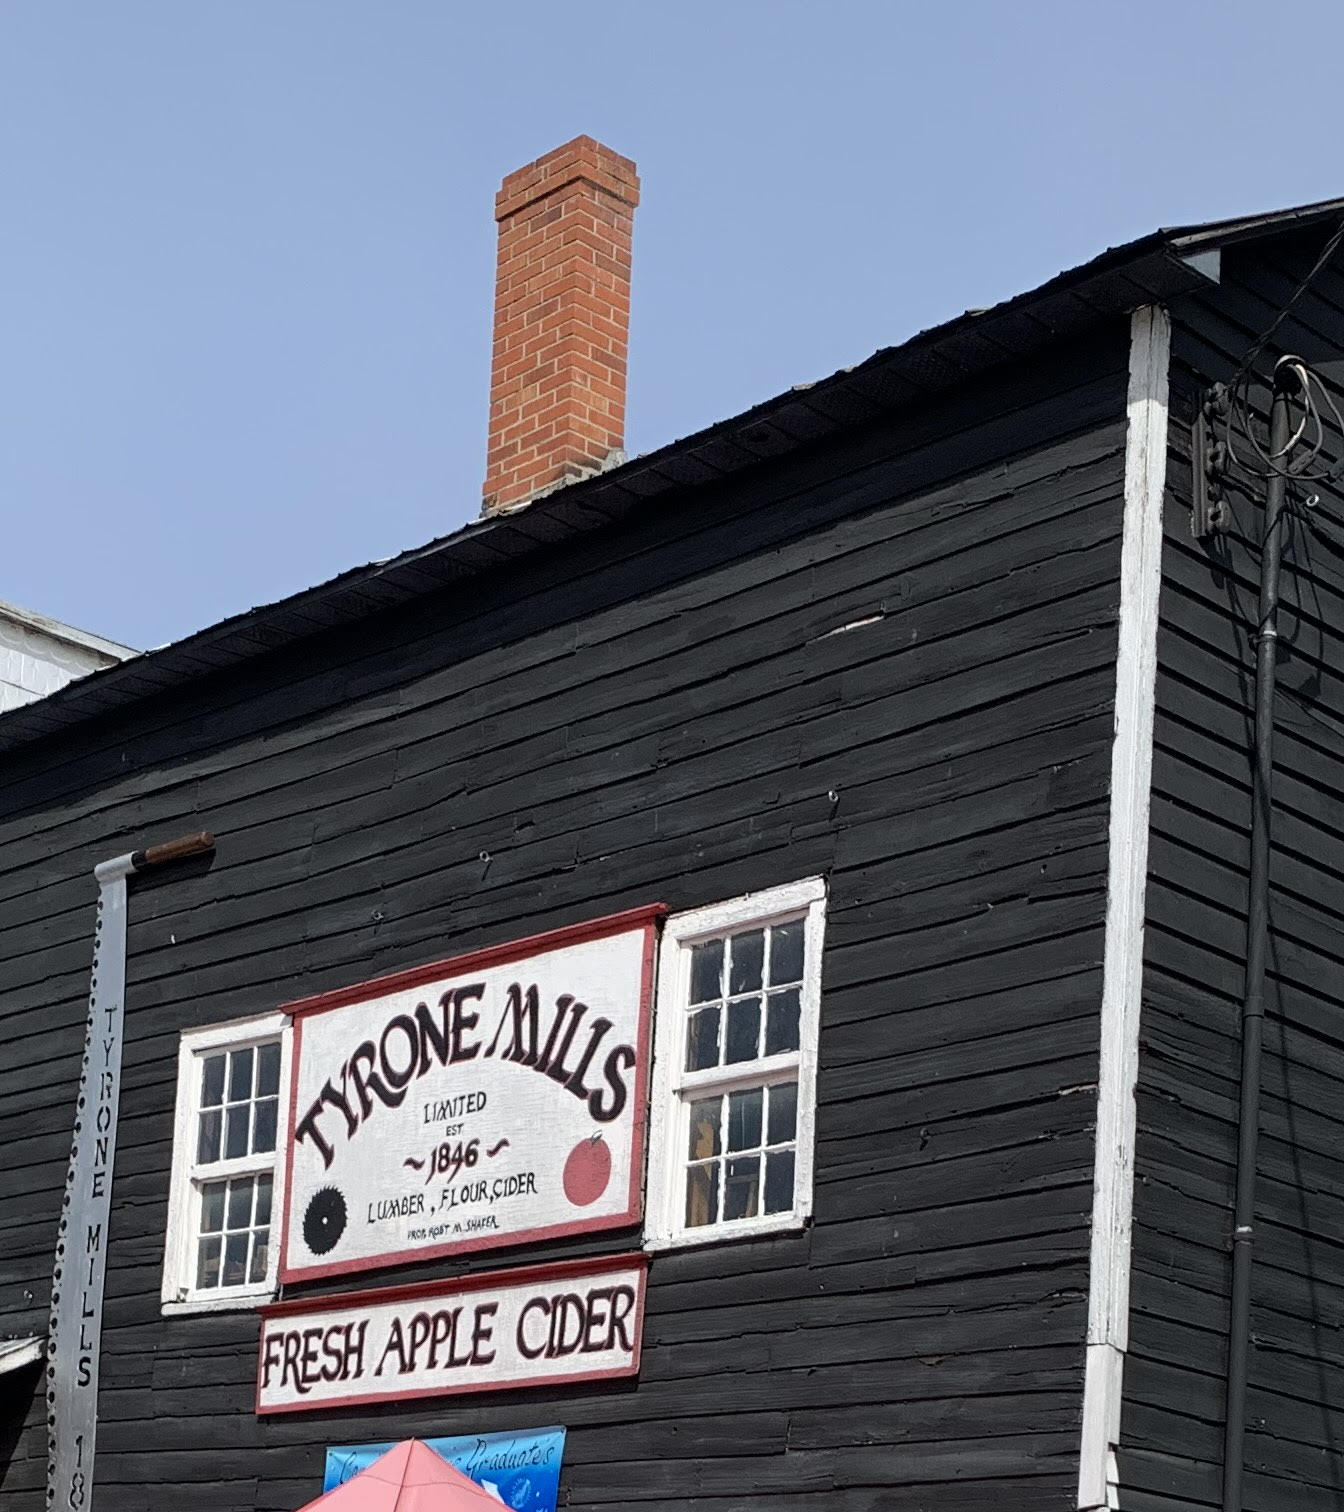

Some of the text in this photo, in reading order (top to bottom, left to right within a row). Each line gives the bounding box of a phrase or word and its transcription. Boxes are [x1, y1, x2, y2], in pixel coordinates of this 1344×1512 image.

[91, 1004, 119, 1200] TYRONE
[295, 982, 637, 1171] TYRONE MILLS
[423, 1091, 487, 1124] LIMITED
[446, 1123, 464, 1136] EST
[76, 1227, 103, 1388] MILLS
[261, 1284, 636, 1394] FRESH APPLE CIDER
